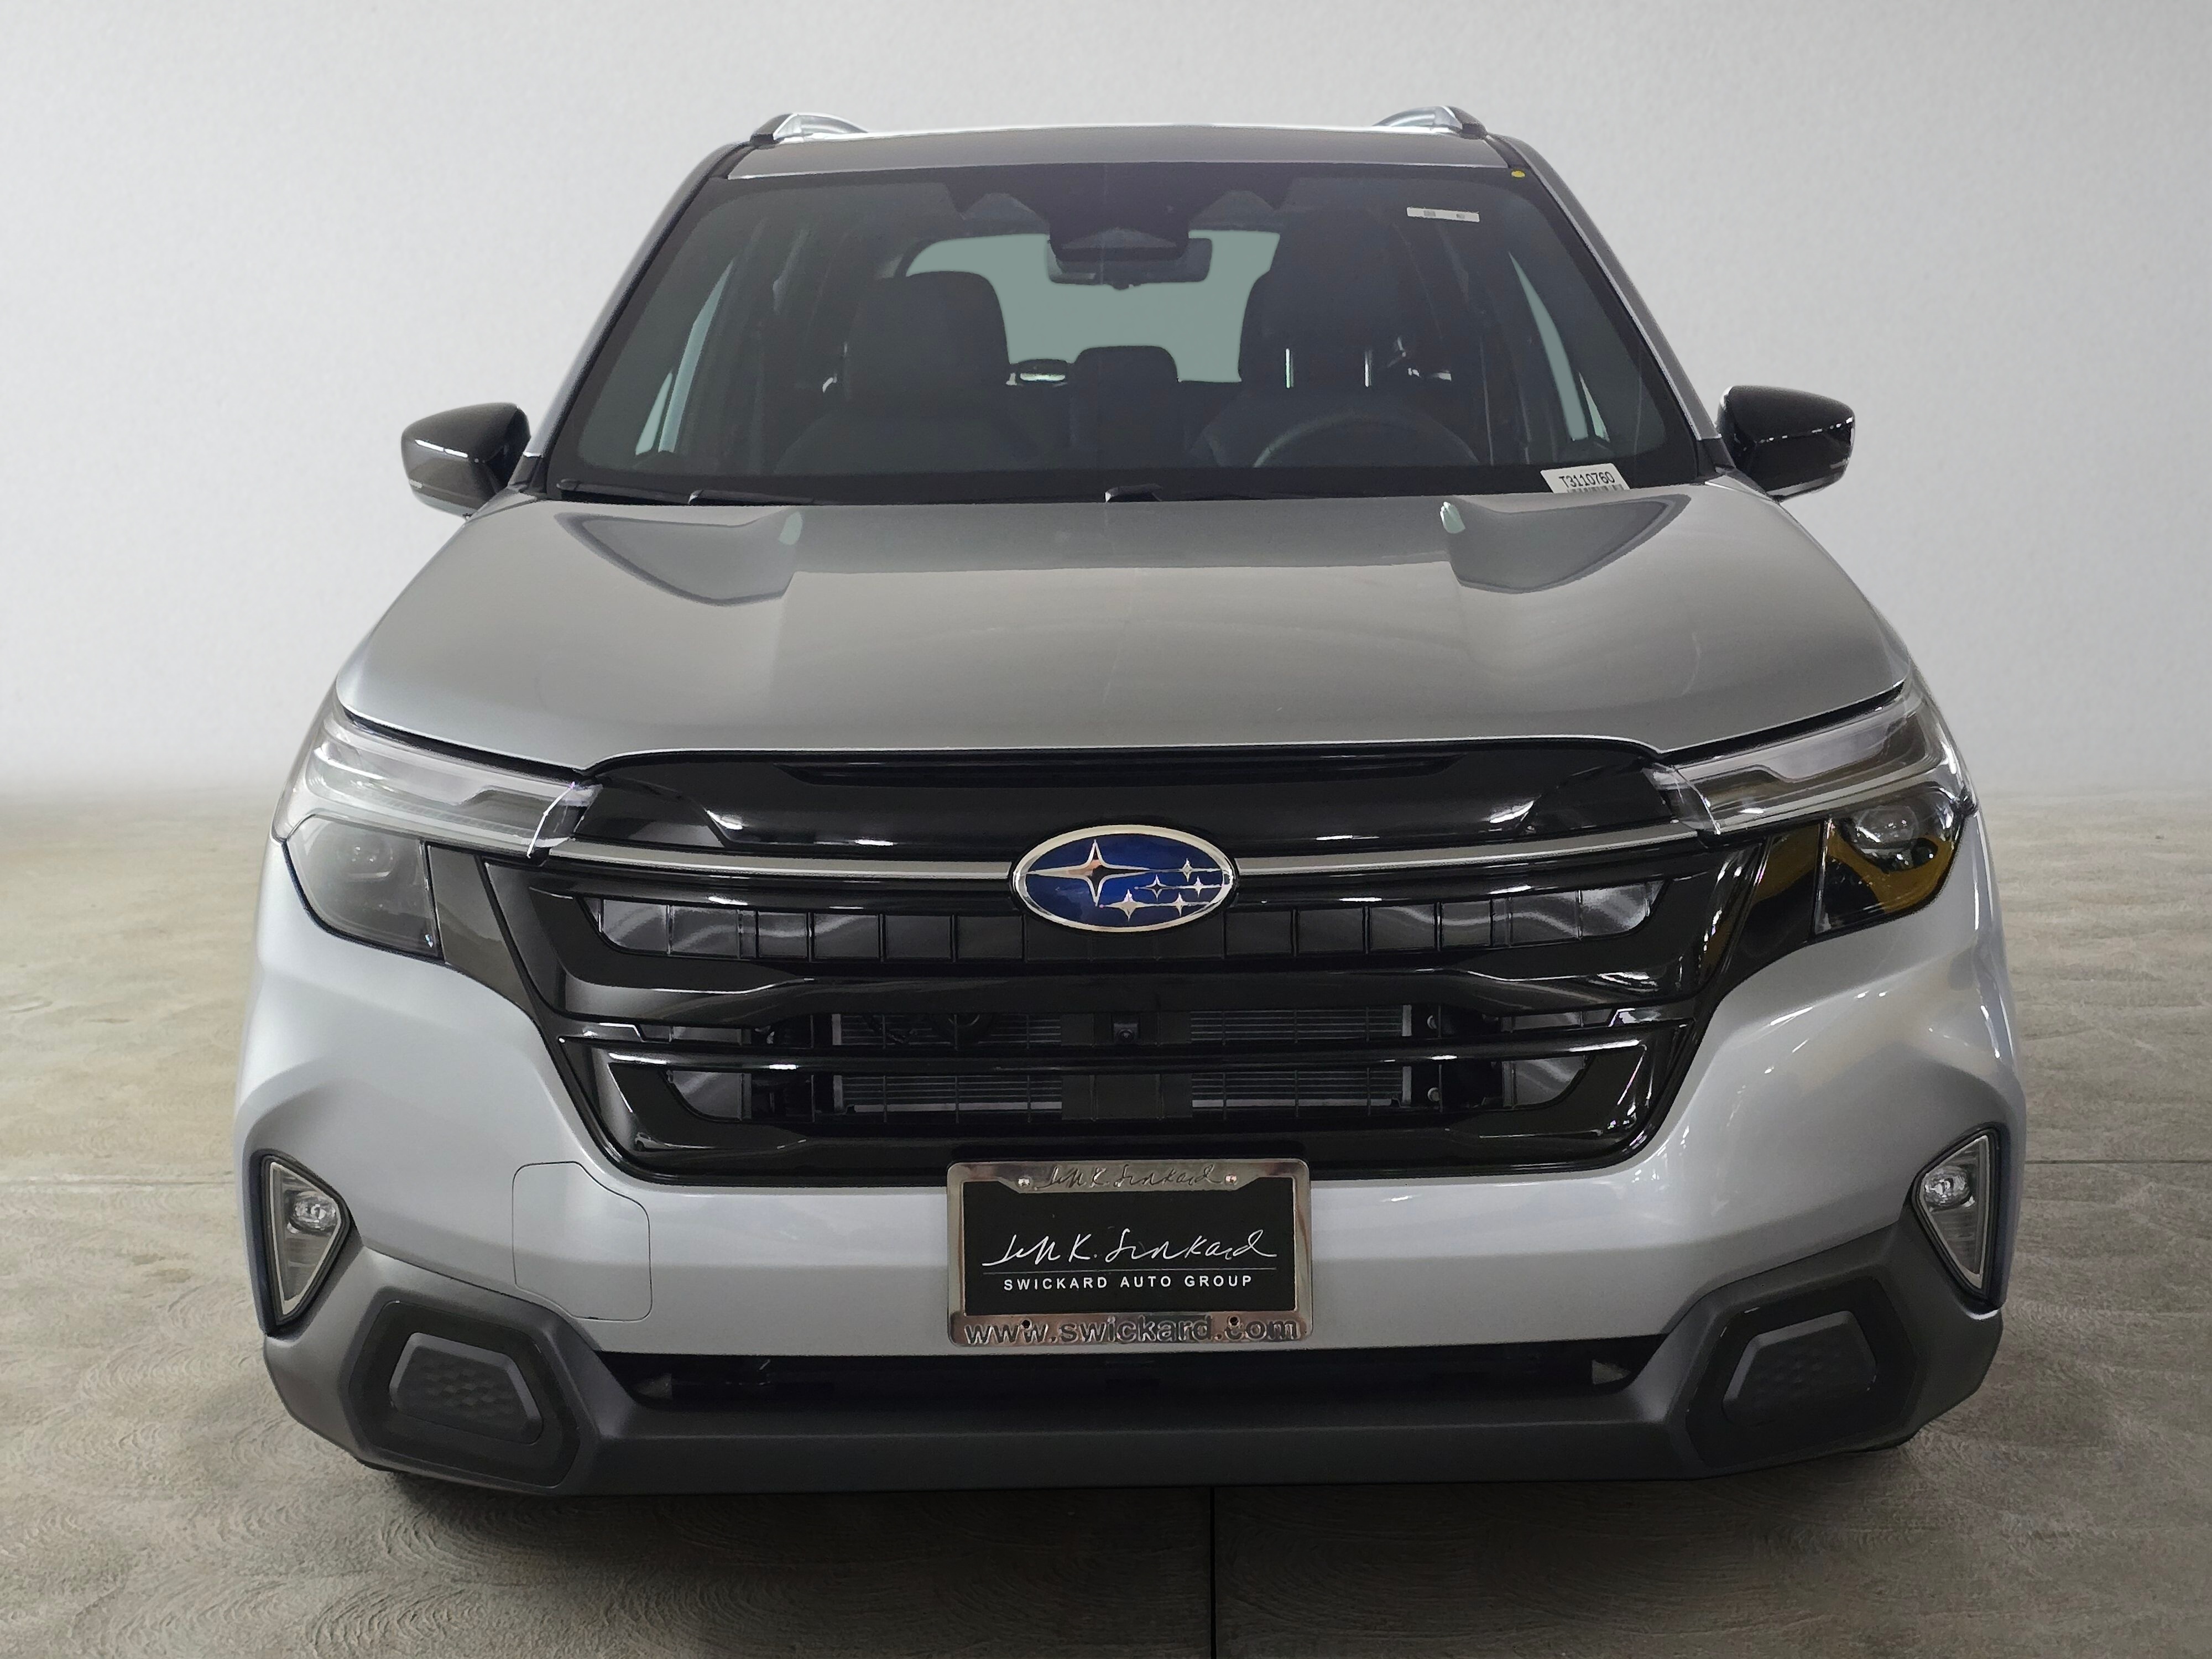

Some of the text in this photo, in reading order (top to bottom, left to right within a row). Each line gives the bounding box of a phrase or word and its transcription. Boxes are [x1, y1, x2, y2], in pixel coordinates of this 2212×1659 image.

[1558, 471, 1615, 488] T3110760
[1004, 1275, 1253, 1291] SWICKARD AUTO GROUP
[964, 1314, 1298, 1345] www.swickard.com
